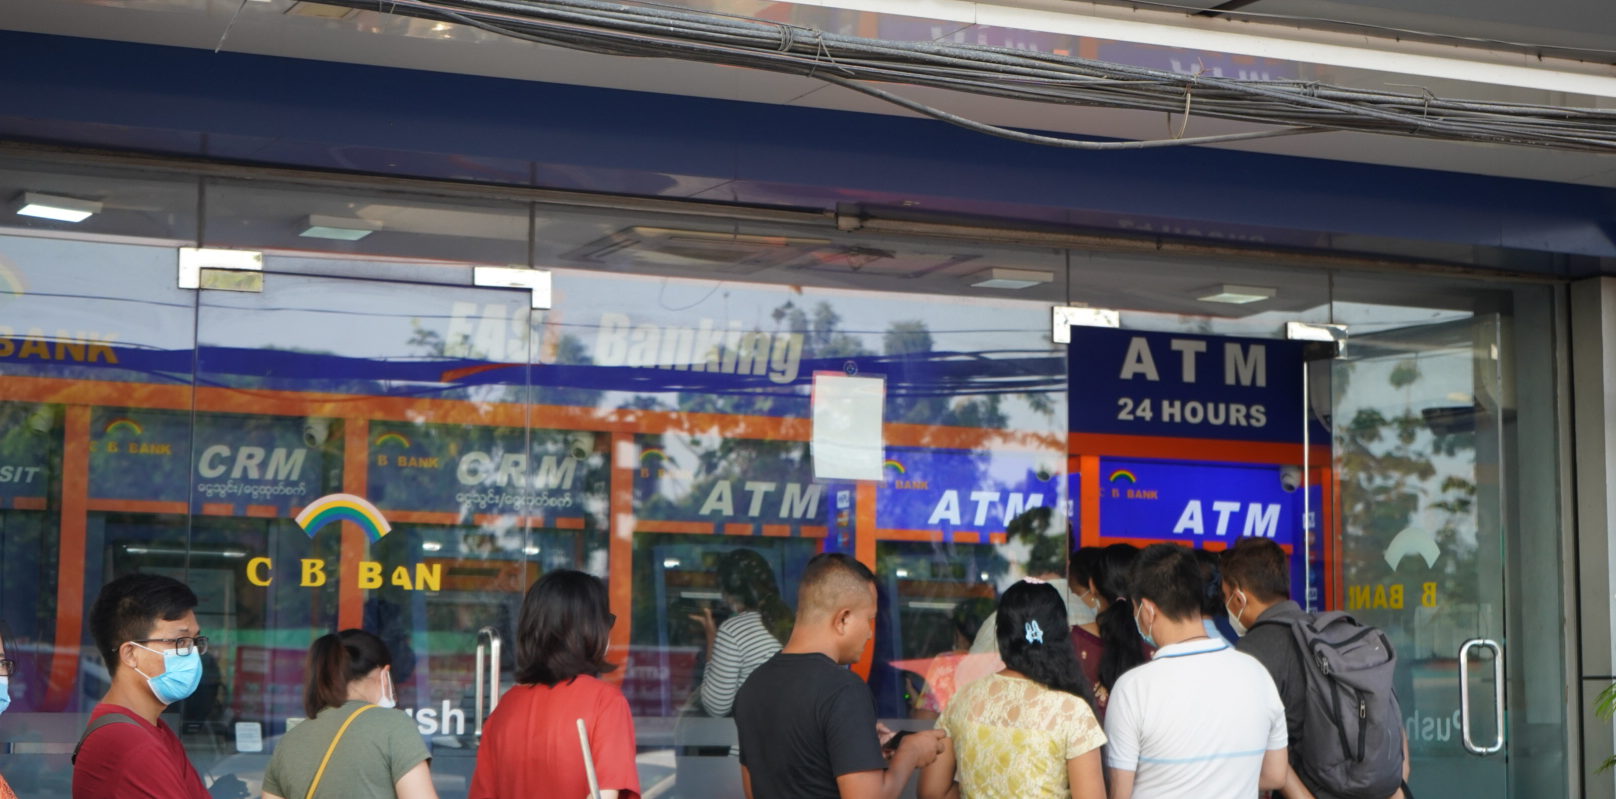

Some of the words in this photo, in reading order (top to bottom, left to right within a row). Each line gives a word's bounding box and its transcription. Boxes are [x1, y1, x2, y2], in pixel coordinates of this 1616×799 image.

[595, 312, 804, 384] Banking
[1117, 397, 1153, 421] 24
[1161, 399, 1267, 428] HOURS
[129, 443, 174, 455] BANK
[198, 444, 307, 481] CRM
[397, 456, 439, 468] BANK
[456, 451, 577, 489] CRM
[699, 480, 822, 519] ATM
[927, 489, 1044, 527] ATM
[1126, 489, 1159, 500] BANK
[1173, 499, 1281, 538] ATM
[246, 557, 273, 587] C
[300, 558, 327, 587] B
[405, 700, 465, 735] sh
